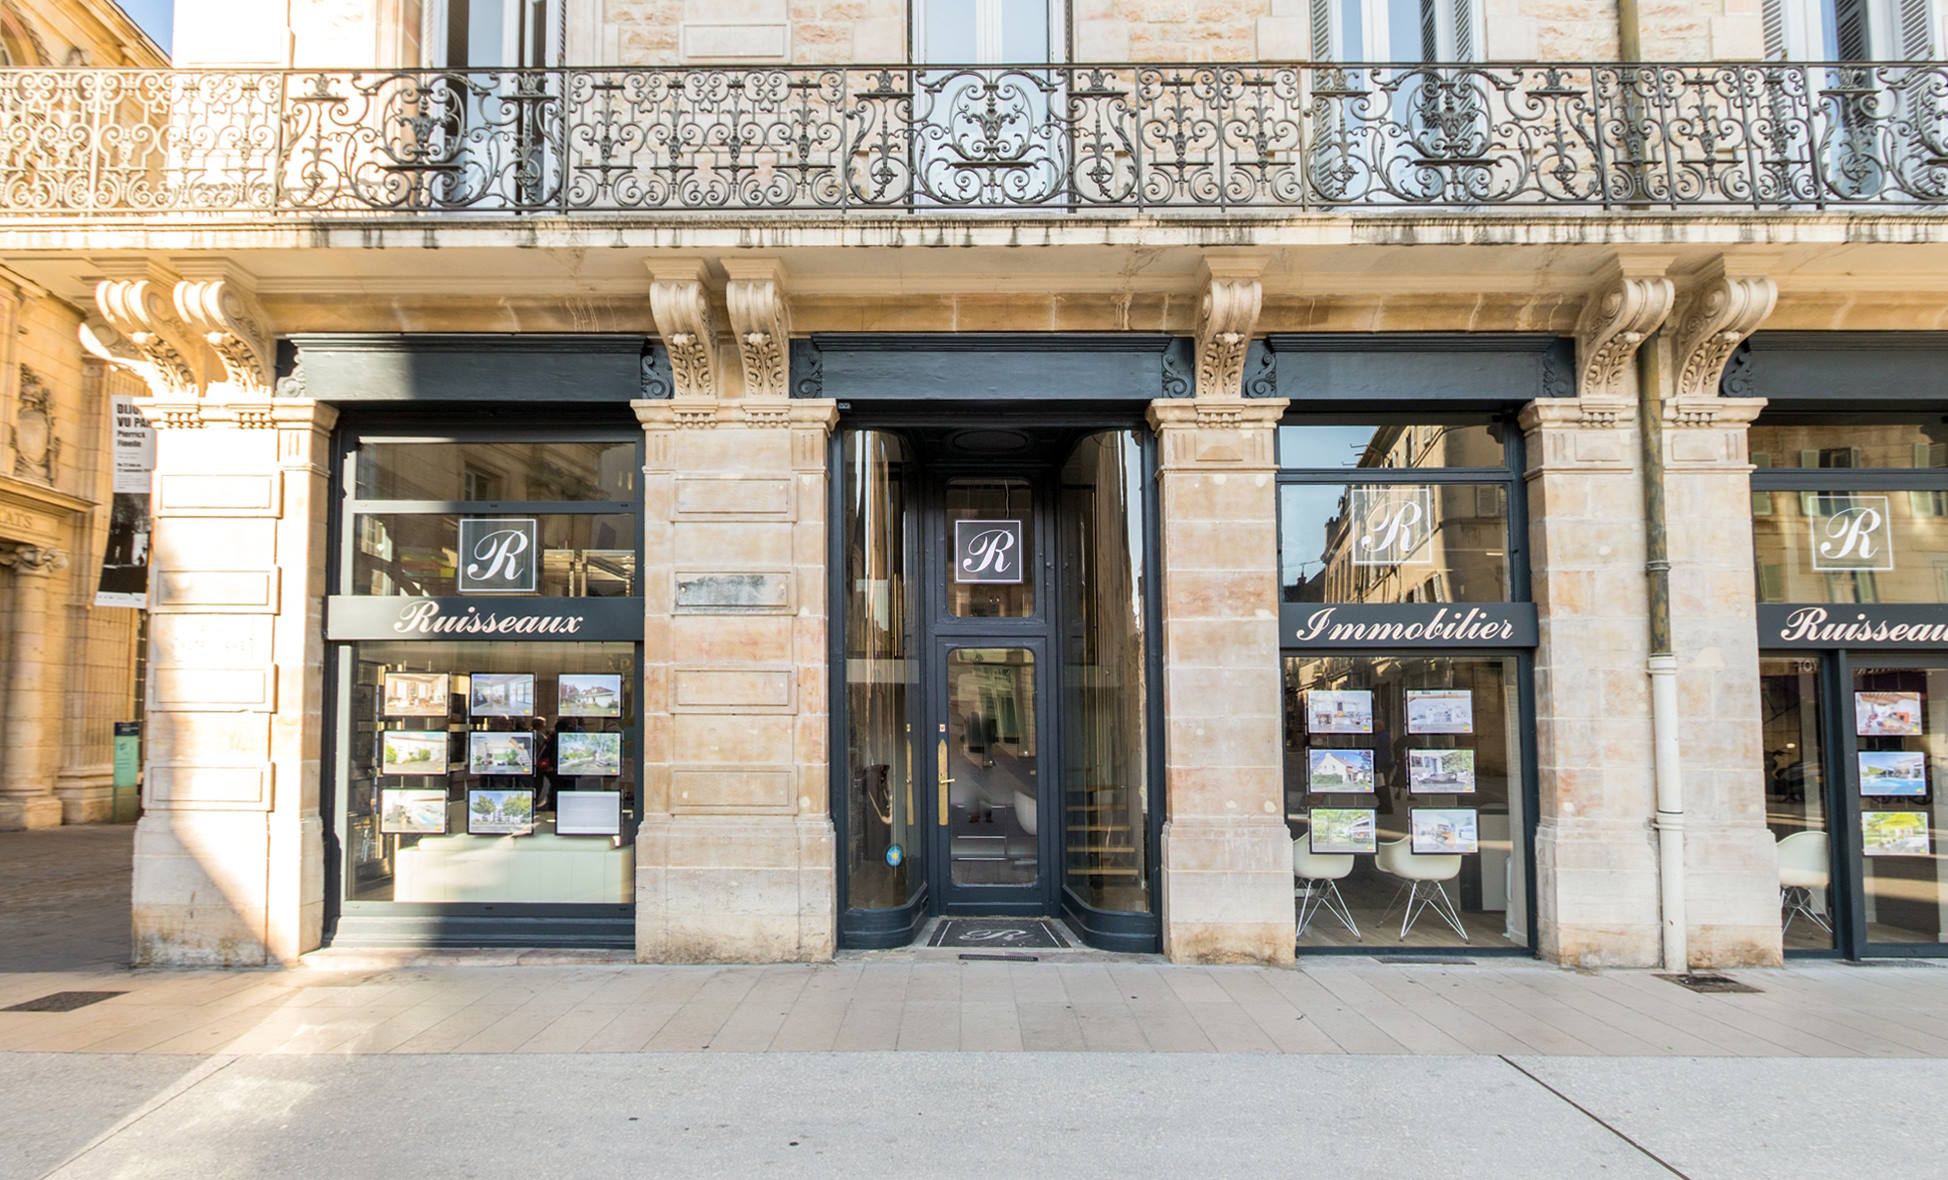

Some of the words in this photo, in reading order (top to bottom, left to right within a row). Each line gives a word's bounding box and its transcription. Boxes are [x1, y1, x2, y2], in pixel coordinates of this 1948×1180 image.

[117, 403, 142, 415] DIJO
[117, 416, 131, 428] VU
[1361, 499, 1423, 554] R
[1819, 507, 1882, 560] R
[466, 529, 529, 581] R
[962, 529, 1015, 573] R
[392, 599, 584, 635] Ruisseaux
[1296, 606, 1514, 641] Immobilier
